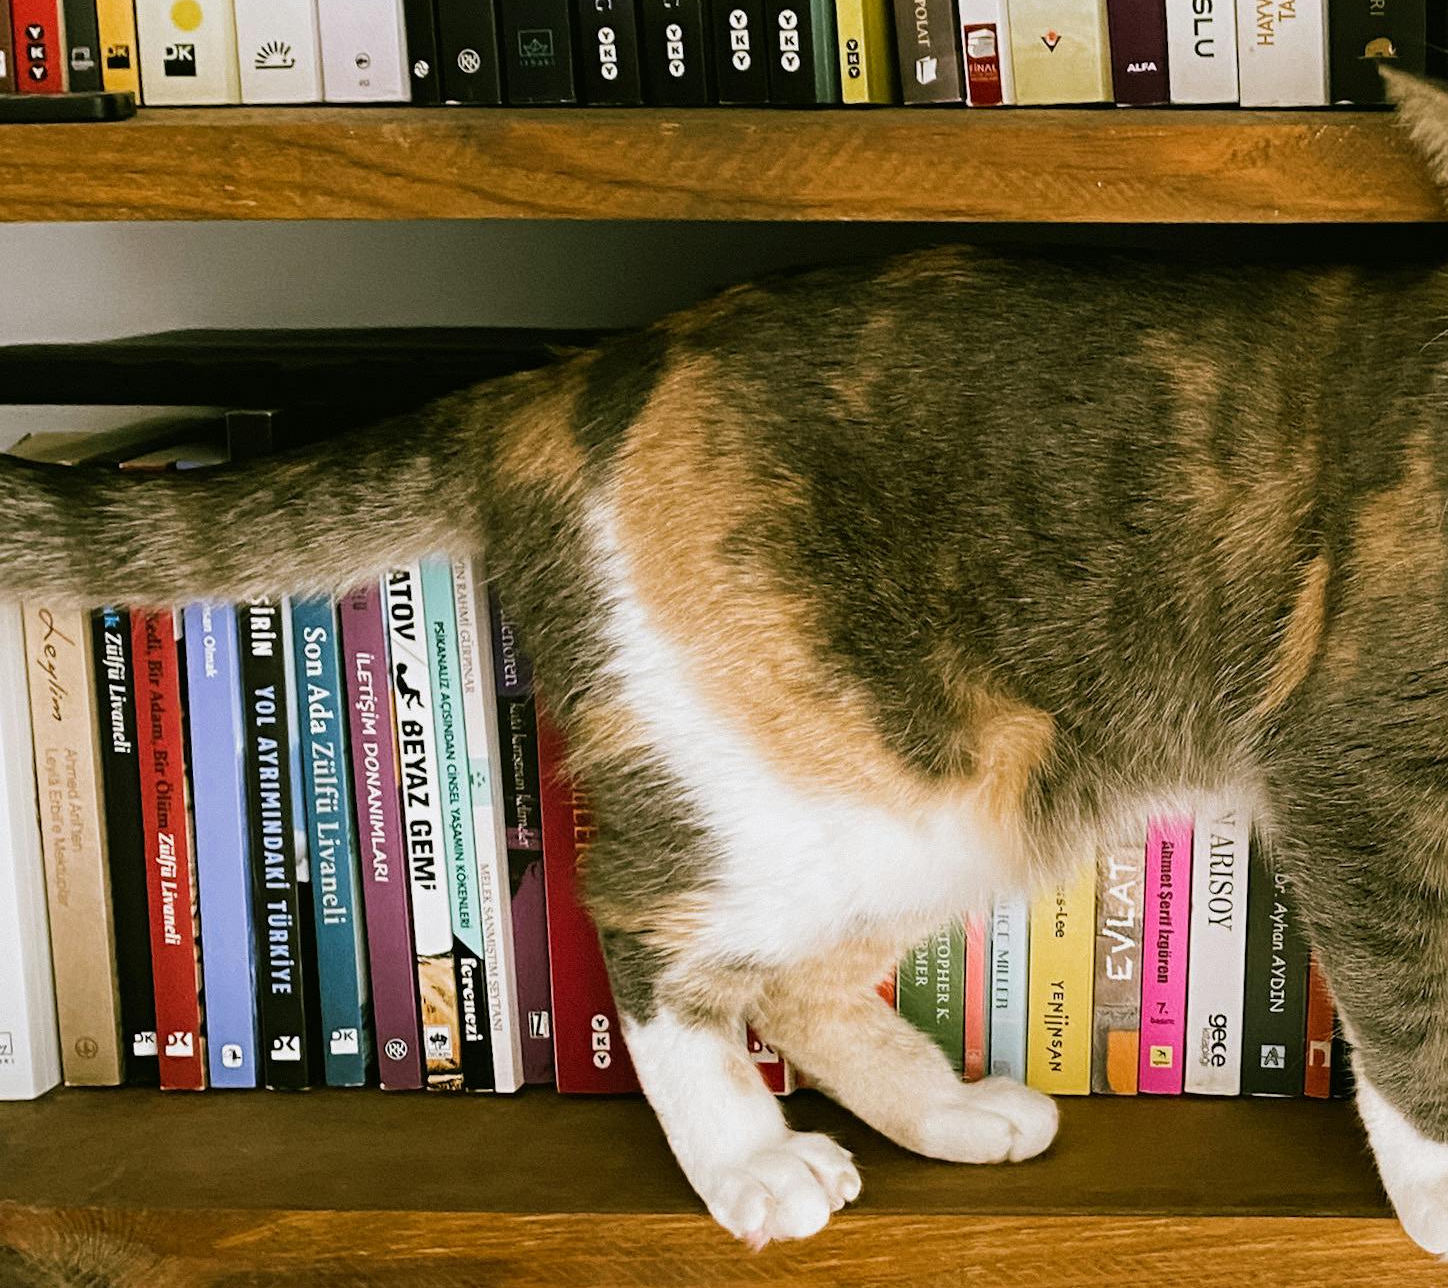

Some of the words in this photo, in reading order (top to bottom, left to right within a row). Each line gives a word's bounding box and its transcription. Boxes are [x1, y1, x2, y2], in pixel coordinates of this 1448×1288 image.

[103, 633, 125, 681] Zülfü
[304, 627, 326, 677] Son
[108, 684, 131, 753] Livaneli
[304, 685, 334, 734] Ada
[355, 652, 378, 735] İLETİŞİM
[312, 743, 341, 816] Zülfü
[401, 720, 430, 807] BEYAZ
[362, 739, 388, 883] DONANIMLARI
[315, 824, 347, 925] Livaneli
[1207, 834, 1235, 932] ARISOY
[1101, 857, 1138, 981] EVLAT
[1270, 902, 1289, 951] Ayhan
[1270, 956, 1285, 1013] AYDIN
[1209, 1014, 1226, 1067] gece
